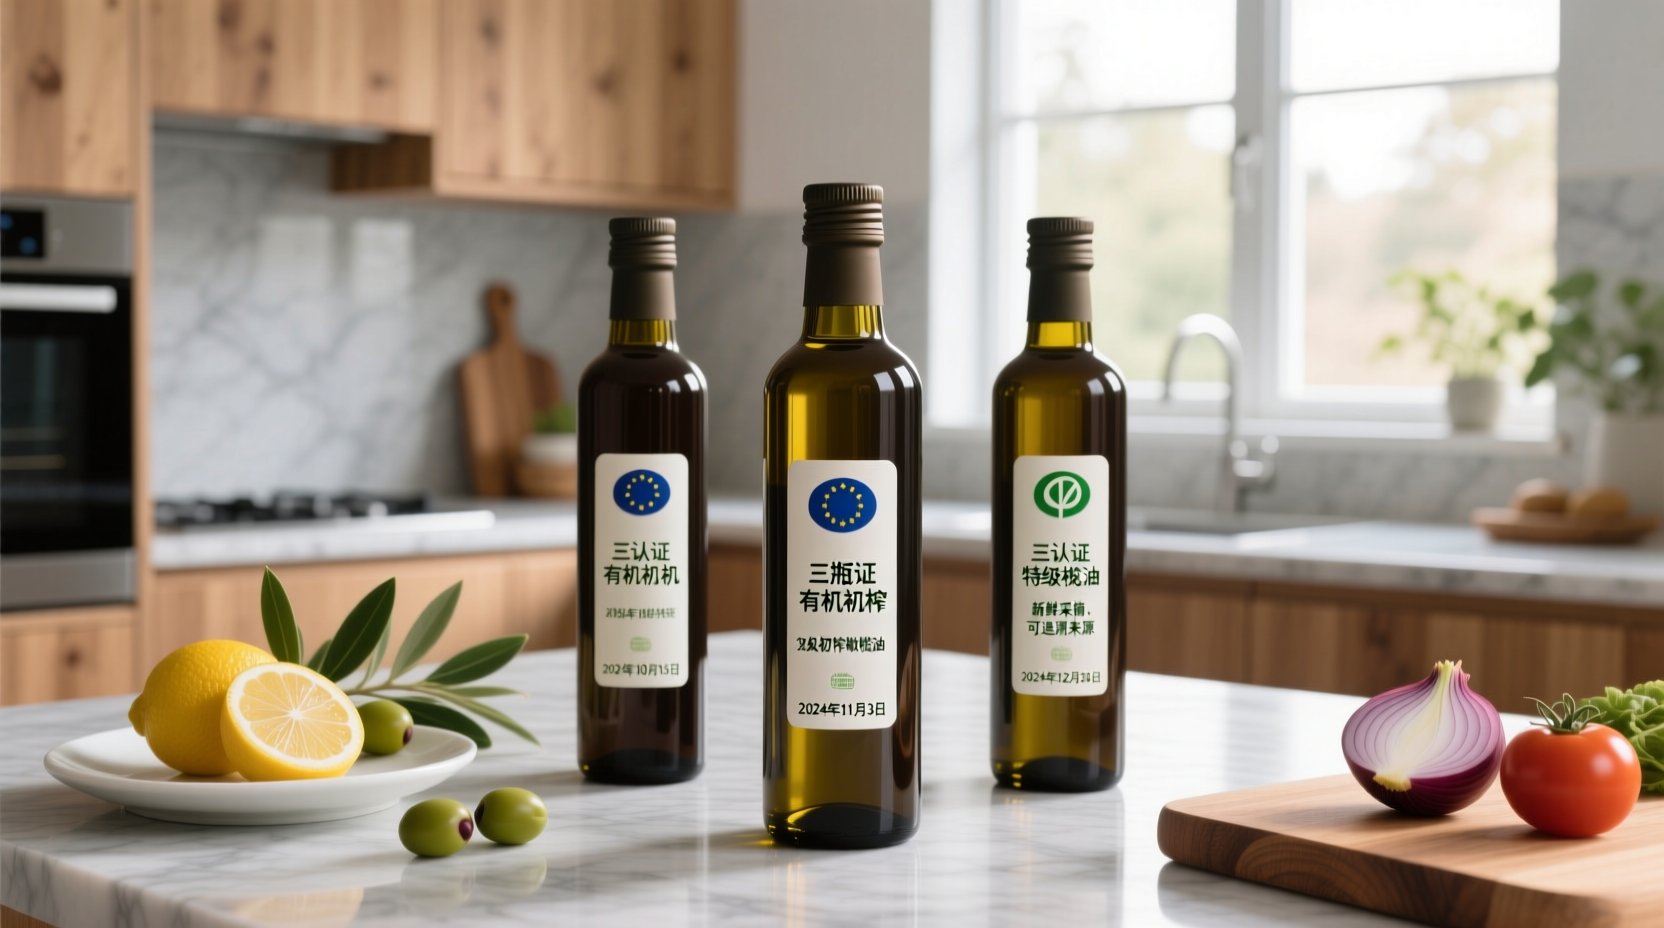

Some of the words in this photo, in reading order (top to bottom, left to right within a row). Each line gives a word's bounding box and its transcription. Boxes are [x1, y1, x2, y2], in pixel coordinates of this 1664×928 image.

[612, 541, 670, 562] 三认证
[1031, 542, 1090, 563] 三认证
[798, 702, 886, 717] 2024年11月3日
